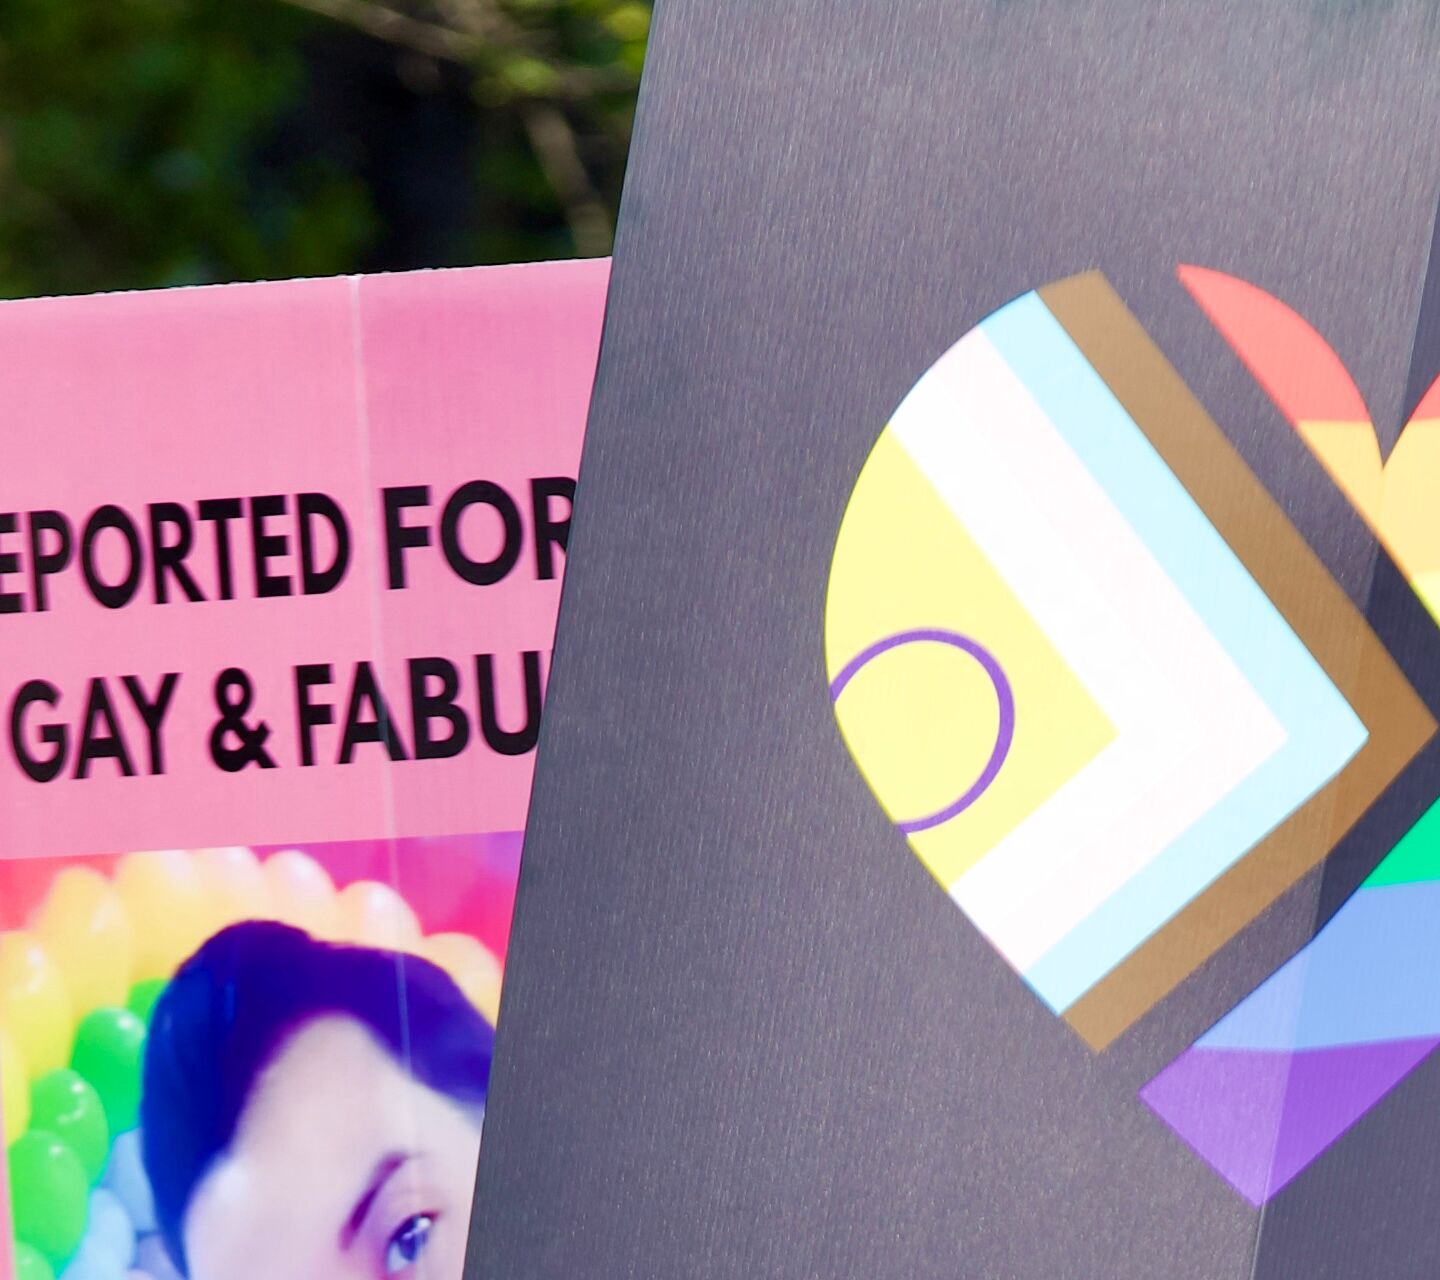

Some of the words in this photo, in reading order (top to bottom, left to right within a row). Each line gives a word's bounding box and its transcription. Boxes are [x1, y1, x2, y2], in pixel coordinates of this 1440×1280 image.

[380, 476, 579, 591] FOR
[7, 672, 181, 783] GAY
[207, 666, 278, 773] &
[293, 649, 554, 768] FABU
